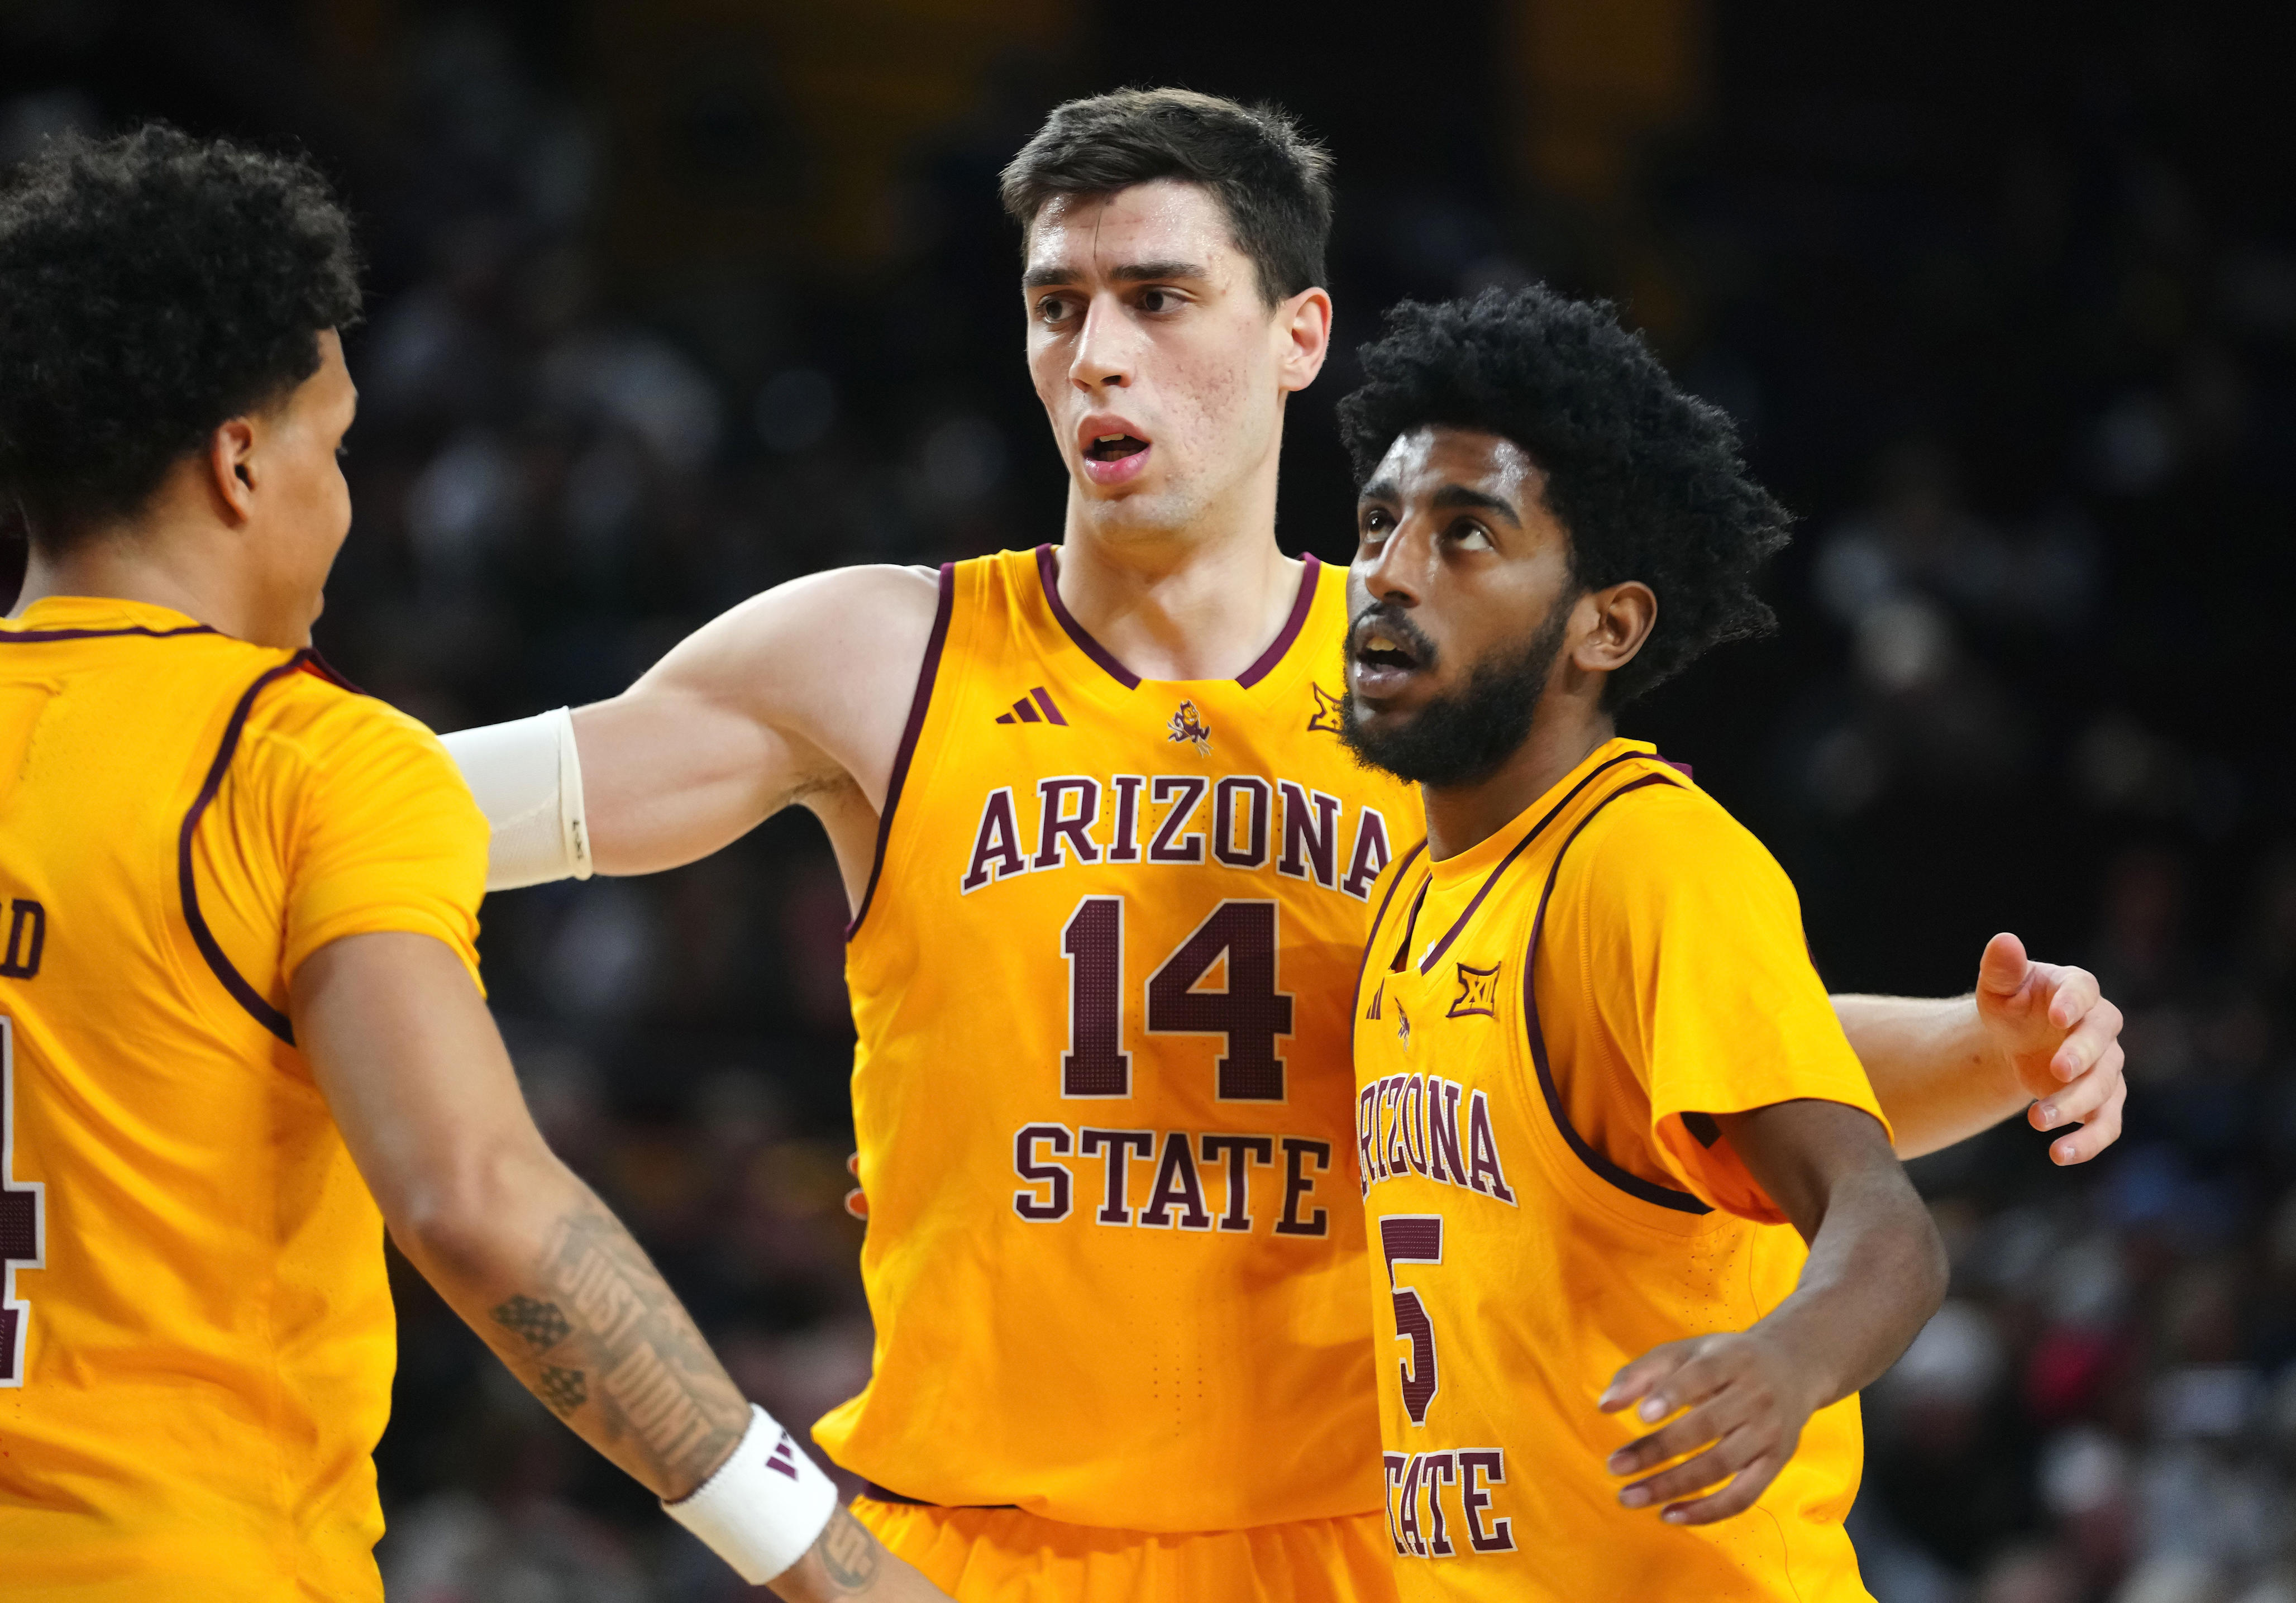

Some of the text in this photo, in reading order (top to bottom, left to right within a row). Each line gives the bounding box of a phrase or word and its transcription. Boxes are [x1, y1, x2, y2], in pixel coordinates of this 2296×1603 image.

[961, 774, 1392, 904] ARIZONA
[1059, 895, 1295, 1103] 14
[1013, 1122, 1332, 1238] STATE
[1357, 1072, 1519, 1208] RIZONA
[1378, 1214, 1444, 1428] 5
[1382, 1447, 1519, 1559] TATE
